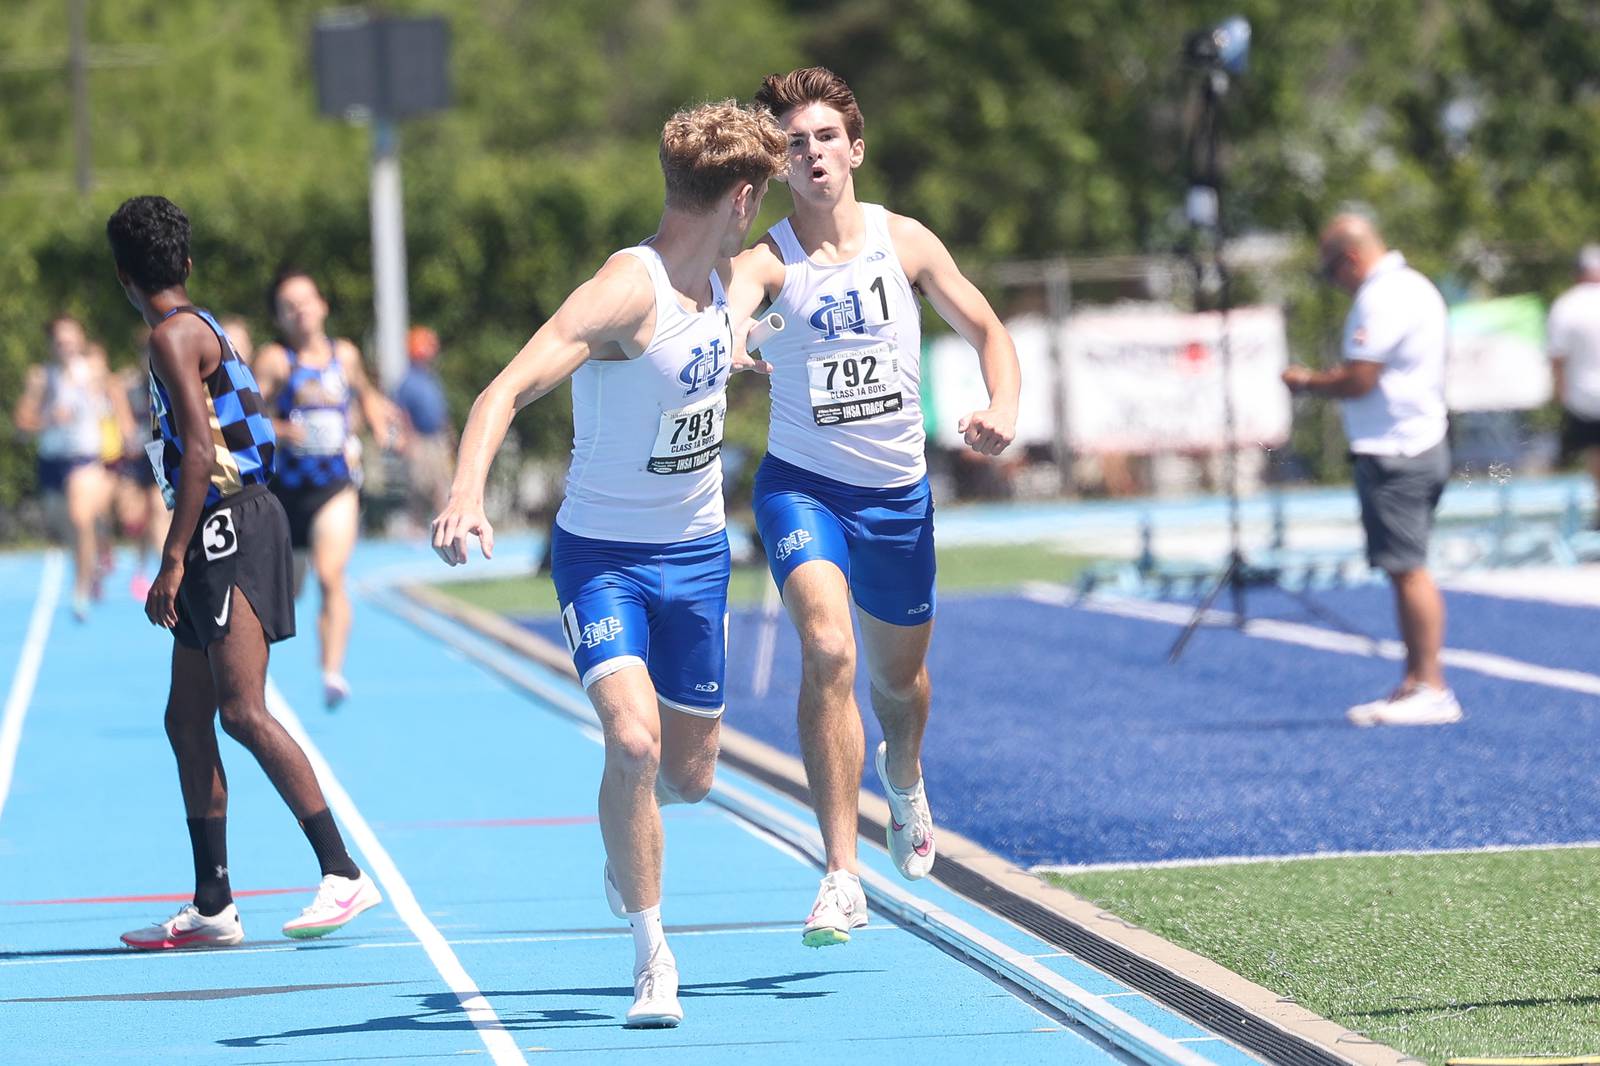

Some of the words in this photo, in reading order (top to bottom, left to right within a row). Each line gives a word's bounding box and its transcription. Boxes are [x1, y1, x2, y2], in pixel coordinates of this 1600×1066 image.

[870, 276, 889, 320] 1
[823, 356, 880, 390] 792
[831, 389, 855, 400] CLASS
[857, 386, 867, 396] 1A
[868, 384, 887, 394] BOYS
[842, 403, 862, 419] IHSA
[861, 400, 884, 416] TRACK
[670, 408, 714, 445] 793
[671, 443, 692, 453] CLASS
[694, 439, 701, 448] 1A
[702, 434, 715, 446] BOYS
[677, 457, 692, 471] IHSA
[693, 451, 710, 468] TRACK
[205, 514, 235, 554] 3
